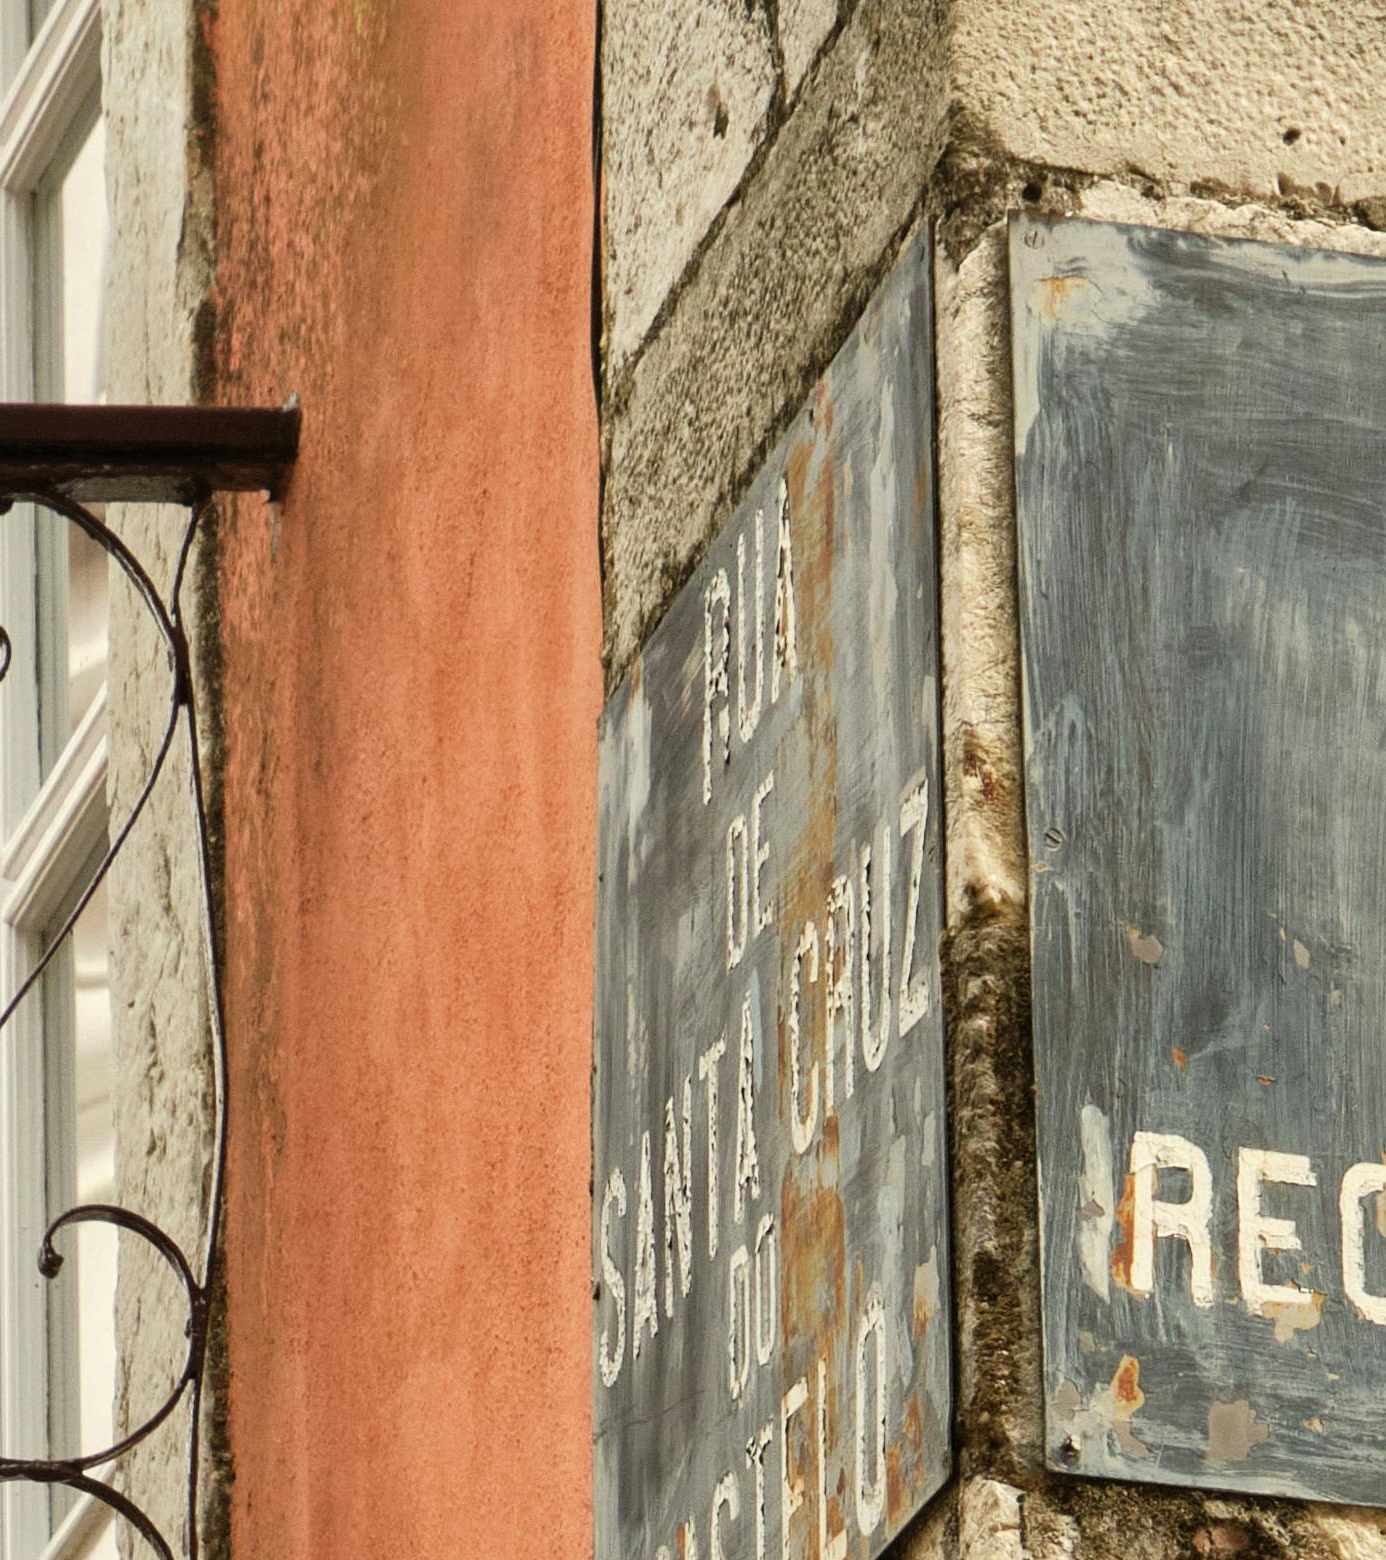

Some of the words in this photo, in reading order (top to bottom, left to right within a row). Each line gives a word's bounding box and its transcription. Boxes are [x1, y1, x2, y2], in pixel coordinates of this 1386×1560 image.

[702, 477, 797, 805] RUA
[726, 771, 774, 971] DE
[599, 990, 761, 1388] SANTA
[789, 768, 930, 1155] CRUZ
[727, 1212, 777, 1400] DO
